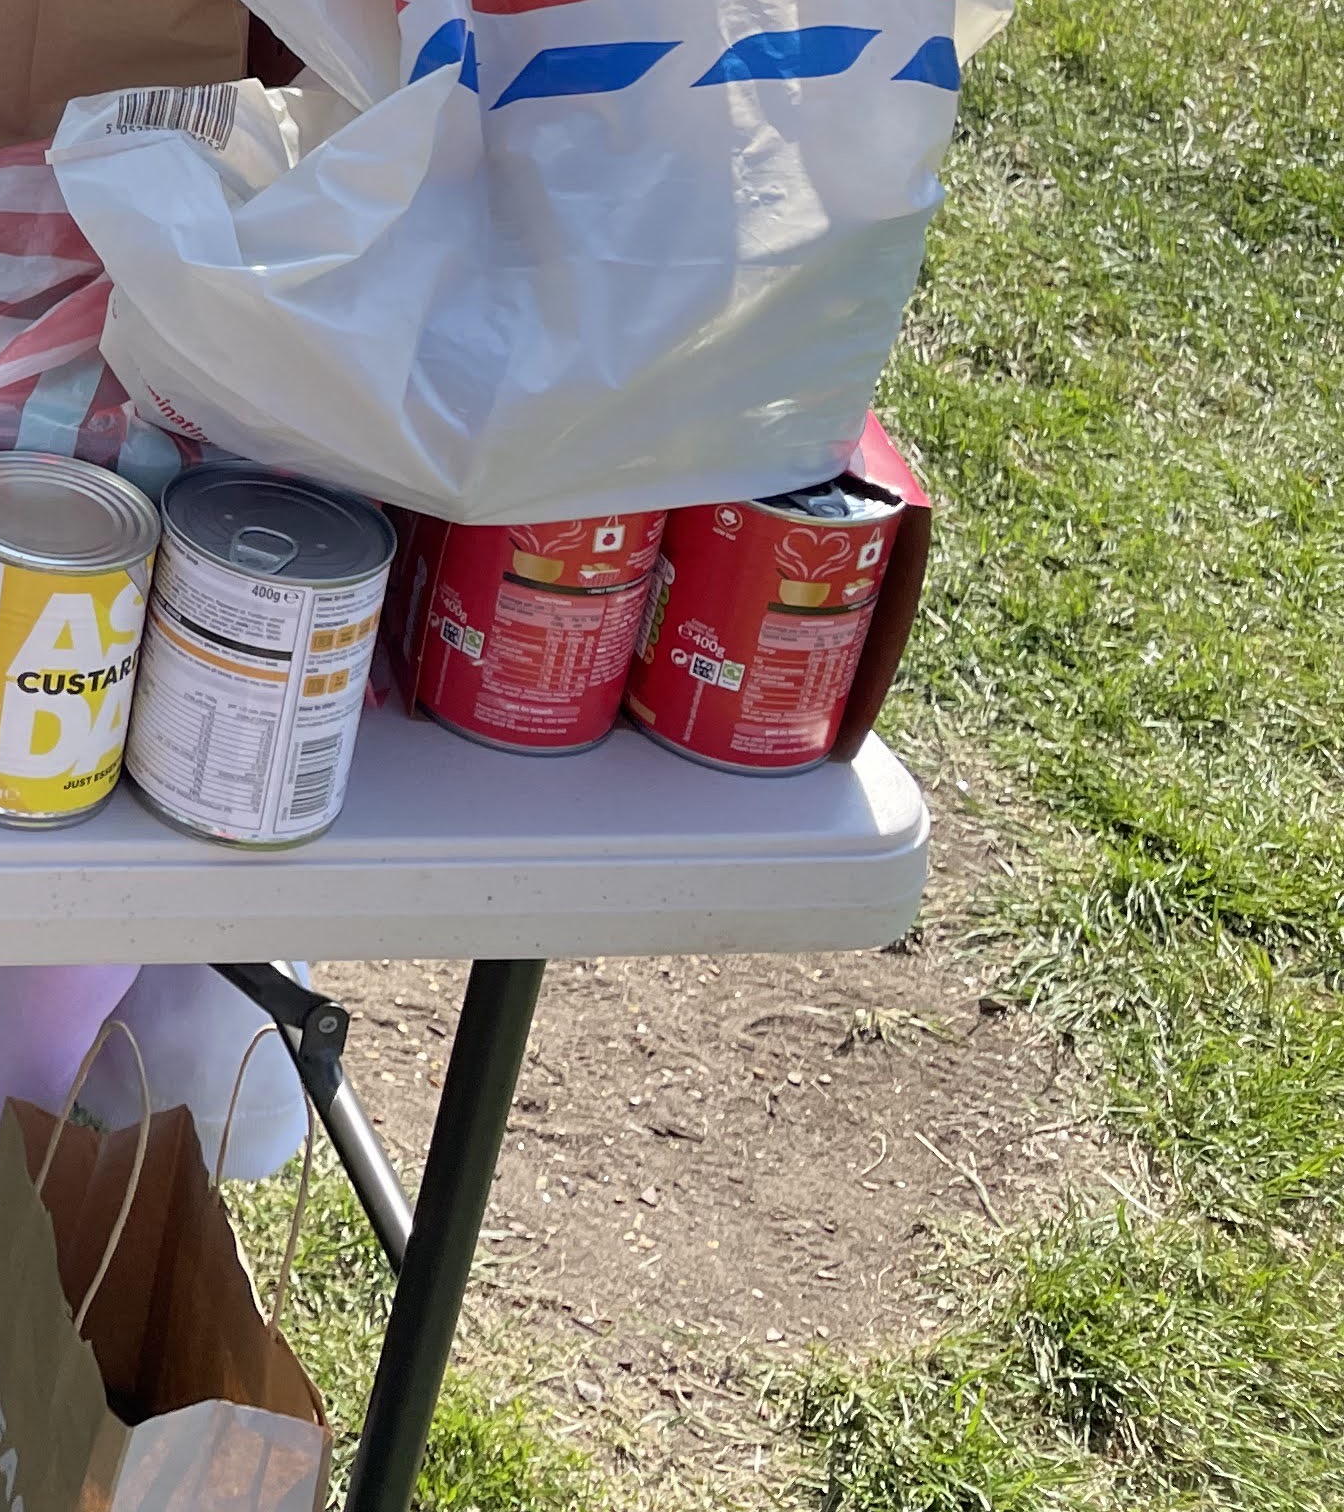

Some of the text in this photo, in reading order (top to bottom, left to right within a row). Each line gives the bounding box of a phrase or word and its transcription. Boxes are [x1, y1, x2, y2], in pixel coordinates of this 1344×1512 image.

[251, 585, 282, 603] 400g
[443, 597, 468, 625] 400g
[692, 633, 726, 658] 400g
[63, 776, 91, 791] JUST
